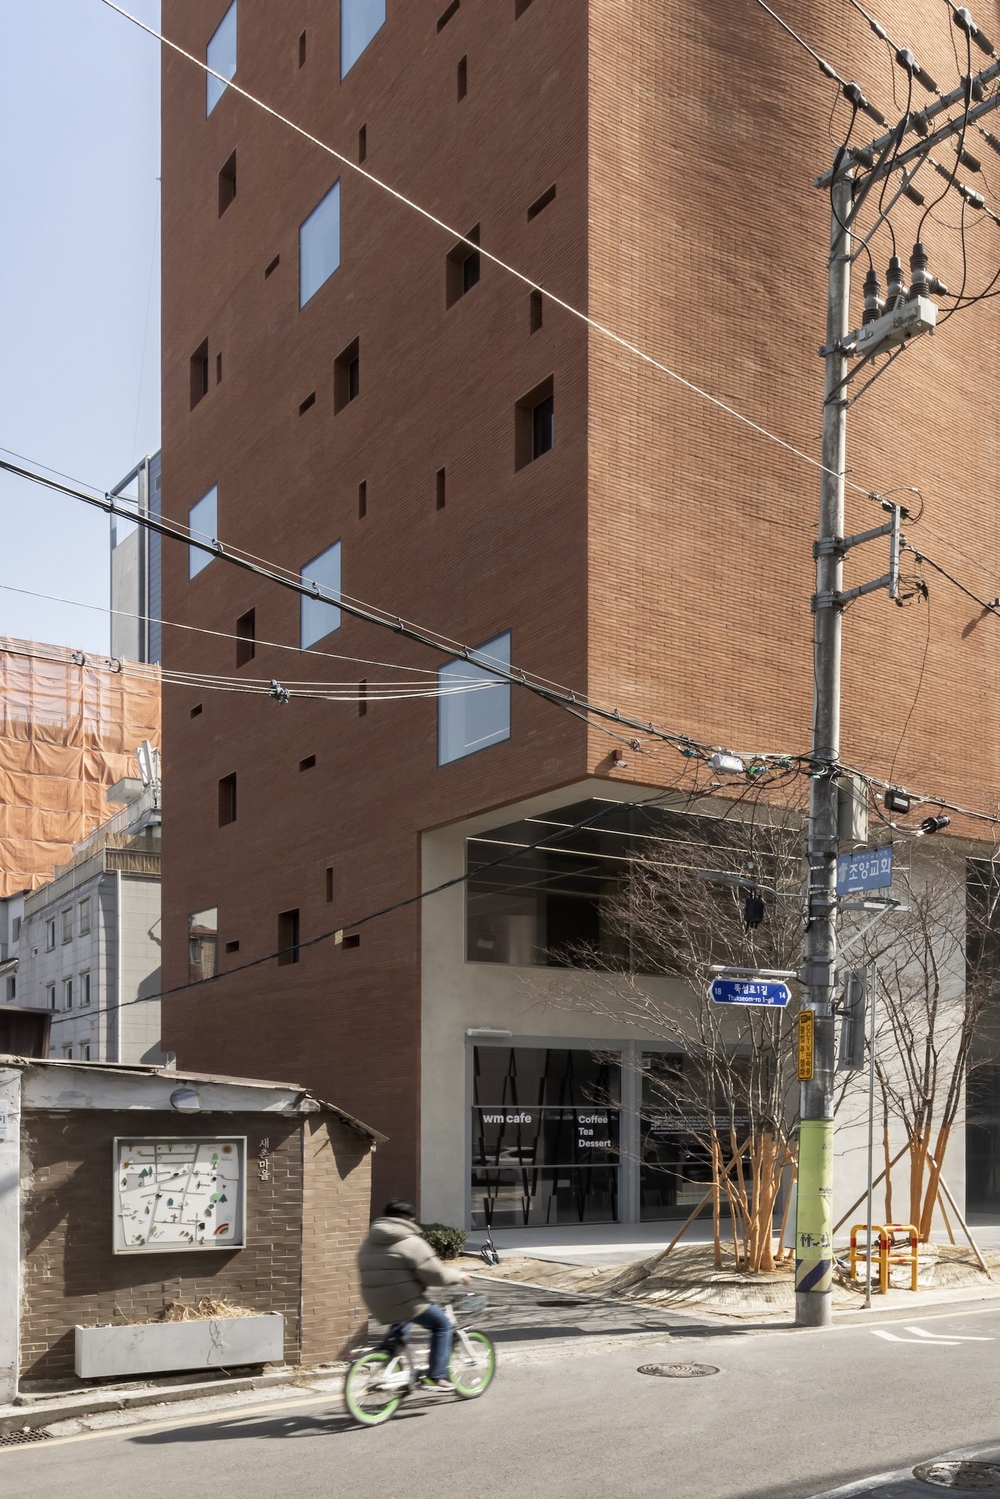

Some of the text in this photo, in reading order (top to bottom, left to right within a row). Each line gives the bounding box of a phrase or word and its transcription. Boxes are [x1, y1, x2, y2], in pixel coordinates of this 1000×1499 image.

[848, 857, 891, 880] 조양교회
[714, 987, 722, 995] 18
[779, 991, 786, 999] 14
[483, 1112, 532, 1124] wm cafe
[578, 1115, 608, 1124] Coffee
[578, 1127, 594, 1136] Tea
[578, 1139, 611, 1148] Dessert
[258, 1137, 270, 1181] 새촌마을
